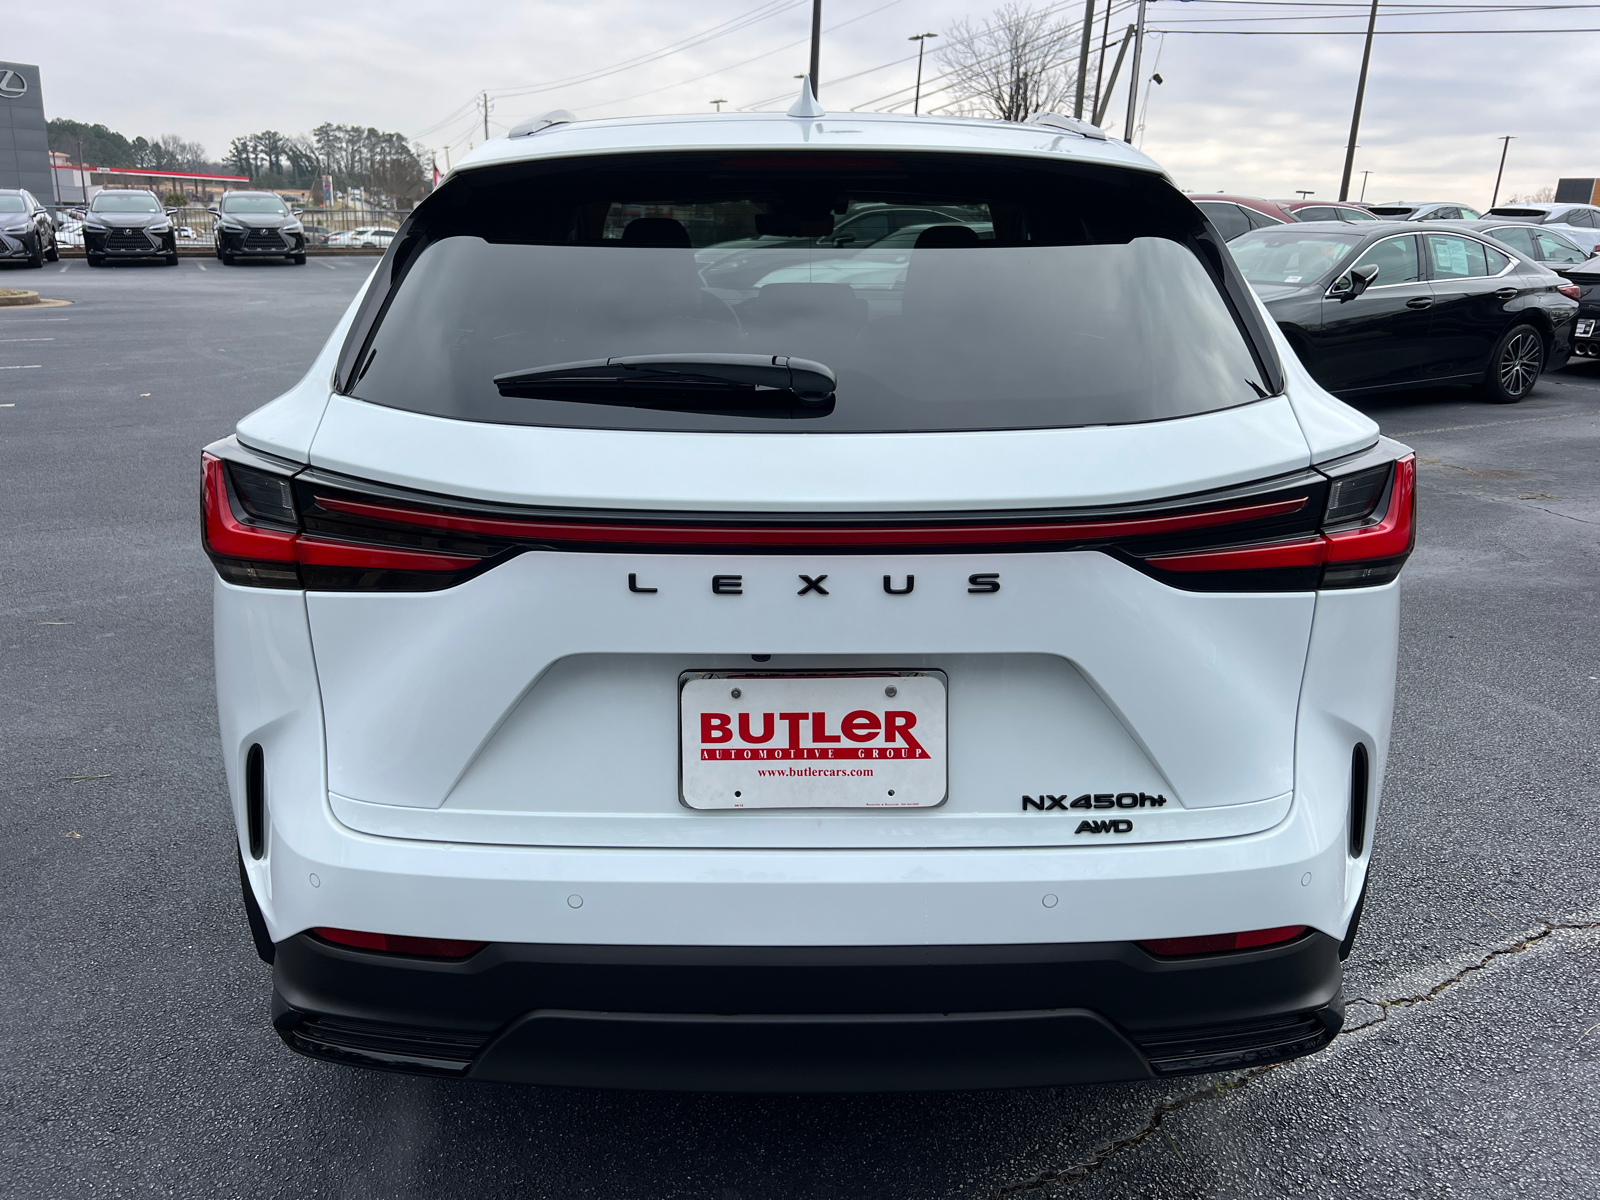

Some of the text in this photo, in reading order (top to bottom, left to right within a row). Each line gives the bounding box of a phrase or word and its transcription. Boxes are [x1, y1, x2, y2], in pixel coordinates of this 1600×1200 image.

[628, 573, 1000, 595] LEXUS
[702, 748, 922, 760] AUTOMOTIVE GROUP
[757, 766, 874, 778] www.butlercars.com
[1022, 792, 1167, 811] NX450h+
[1074, 819, 1134, 835] AWD
